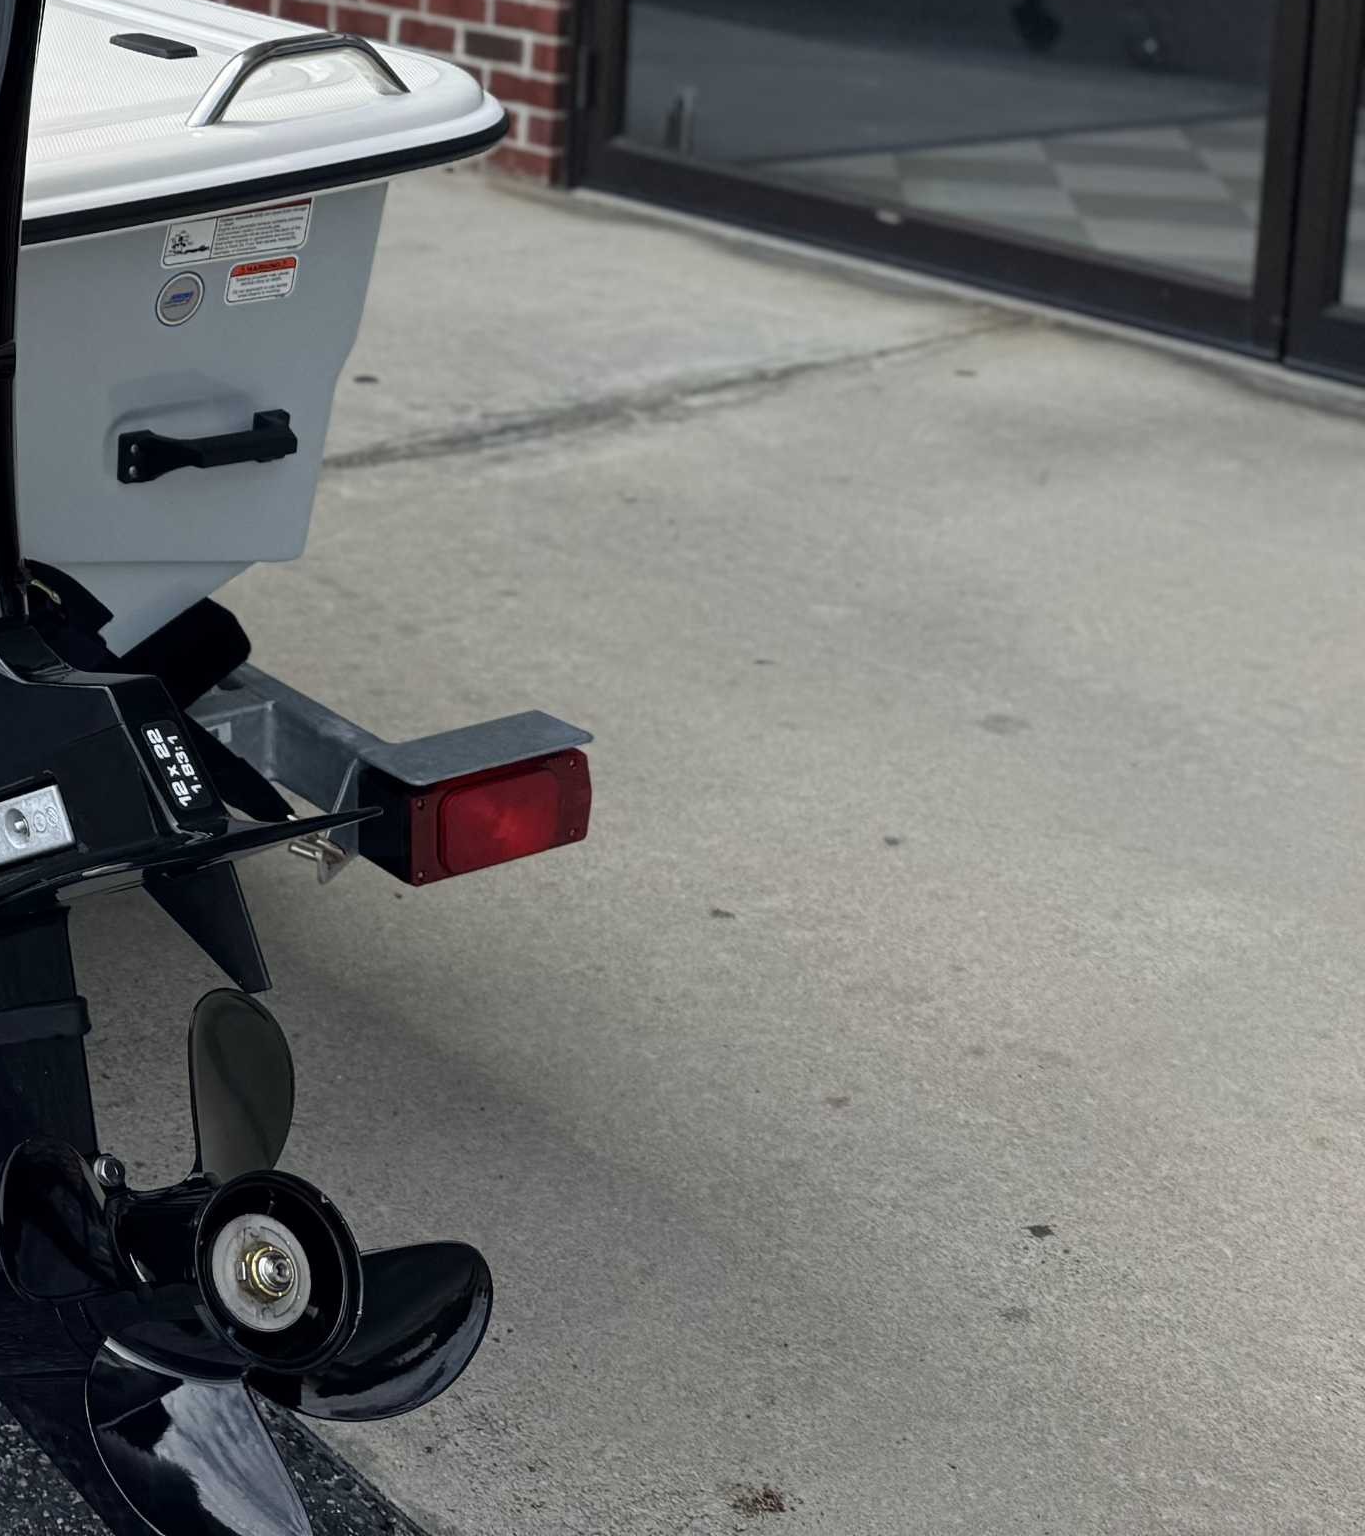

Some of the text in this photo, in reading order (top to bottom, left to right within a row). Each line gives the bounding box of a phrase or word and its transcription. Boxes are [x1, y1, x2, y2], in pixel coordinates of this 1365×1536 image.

[146, 727, 171, 760] 22
[166, 735, 202, 794] 1.83:1
[171, 779, 193, 807] 12
